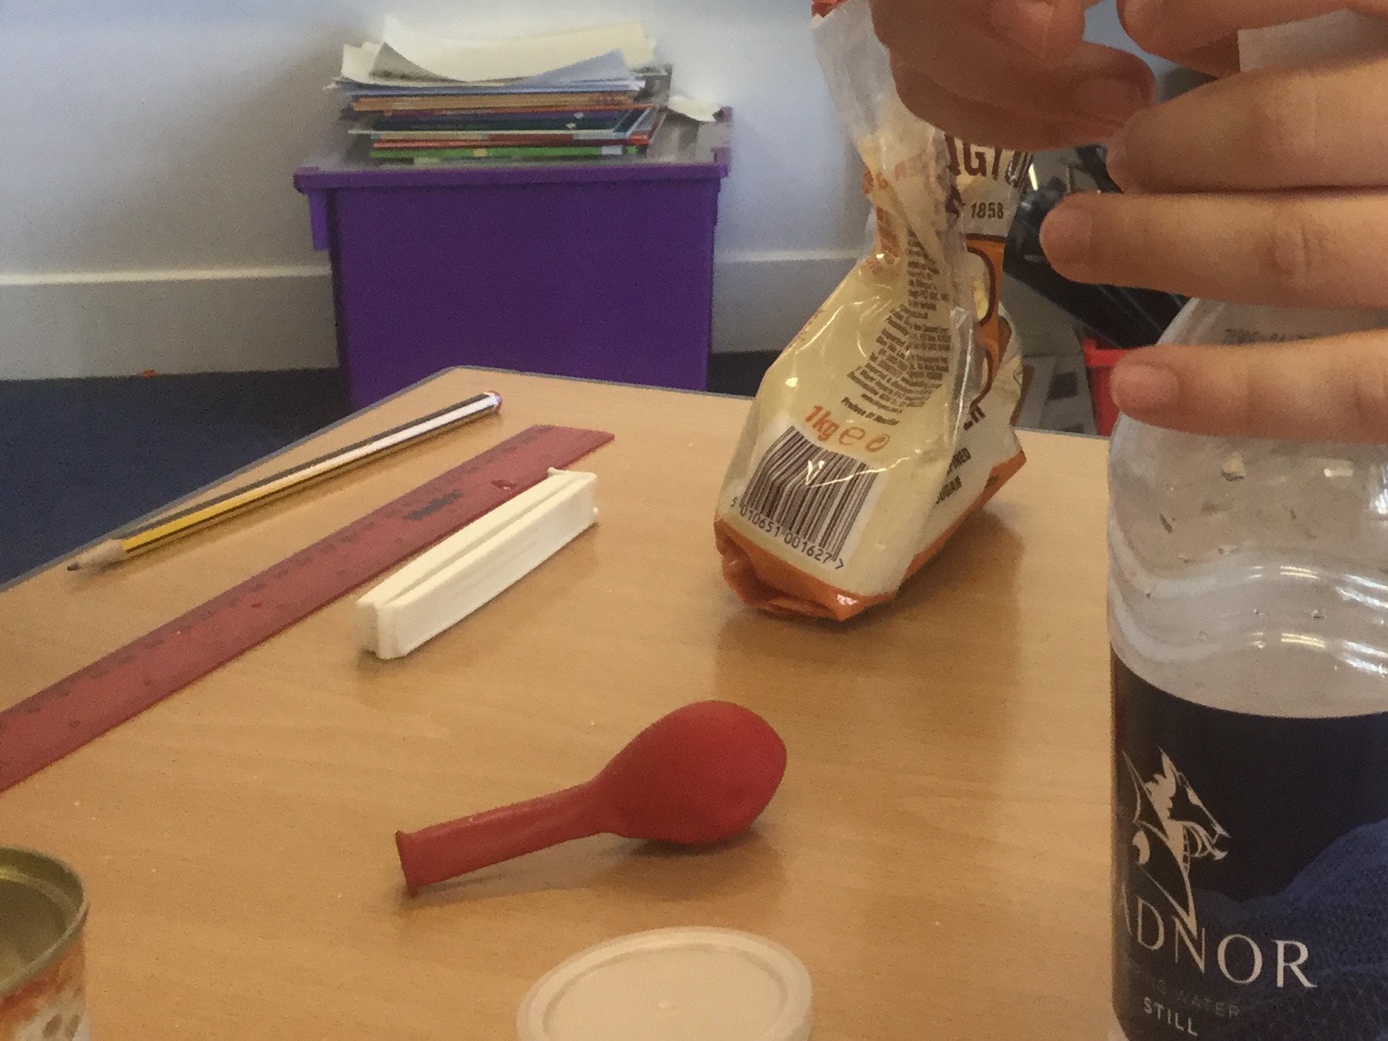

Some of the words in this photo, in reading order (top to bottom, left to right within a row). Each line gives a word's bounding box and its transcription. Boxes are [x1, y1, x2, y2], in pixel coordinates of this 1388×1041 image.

[970, 201, 1005, 219] 1858
[805, 404, 840, 442] 1kg
[739, 506, 782, 538] 010651
[1143, 995, 1199, 1038] STILL
